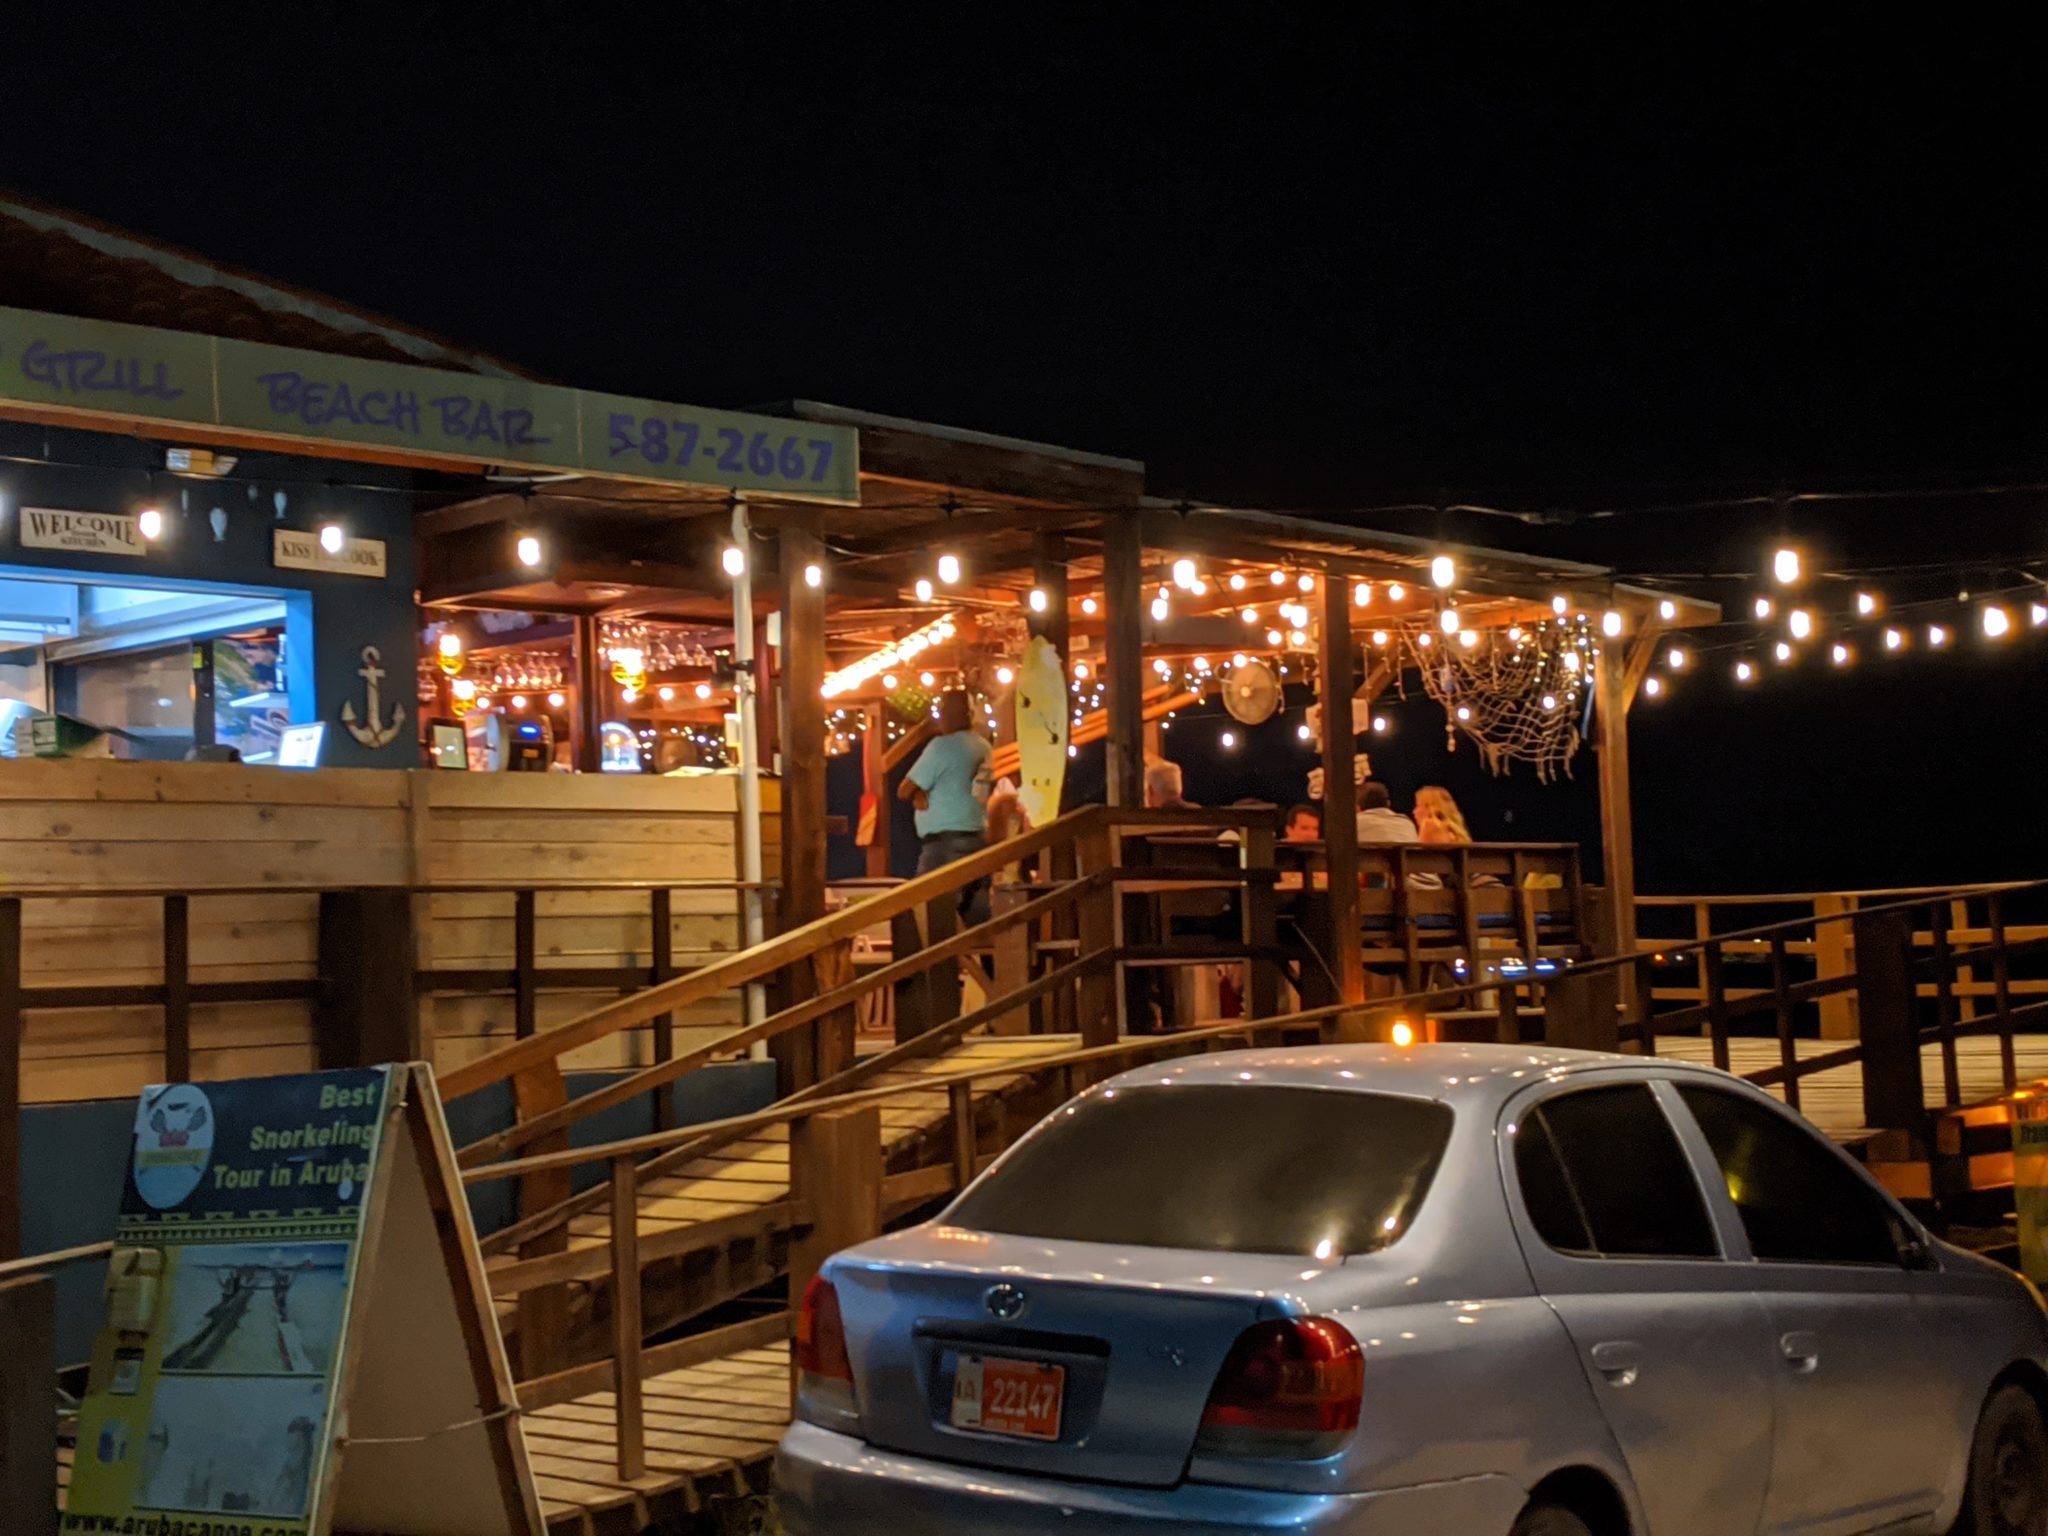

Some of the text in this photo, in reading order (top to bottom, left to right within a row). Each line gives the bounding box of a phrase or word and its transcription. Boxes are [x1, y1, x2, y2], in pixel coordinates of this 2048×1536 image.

[21, 338, 184, 400] GRILL
[258, 371, 551, 447] BEACH BAR
[608, 412, 833, 482] 587-2667
[29, 511, 136, 546] WELCOME
[319, 1083, 376, 1110] Best
[250, 1119, 376, 1151] Snorkeling
[213, 1157, 370, 1189] Tour in Aruba
[990, 1378, 1055, 1420] 22147
